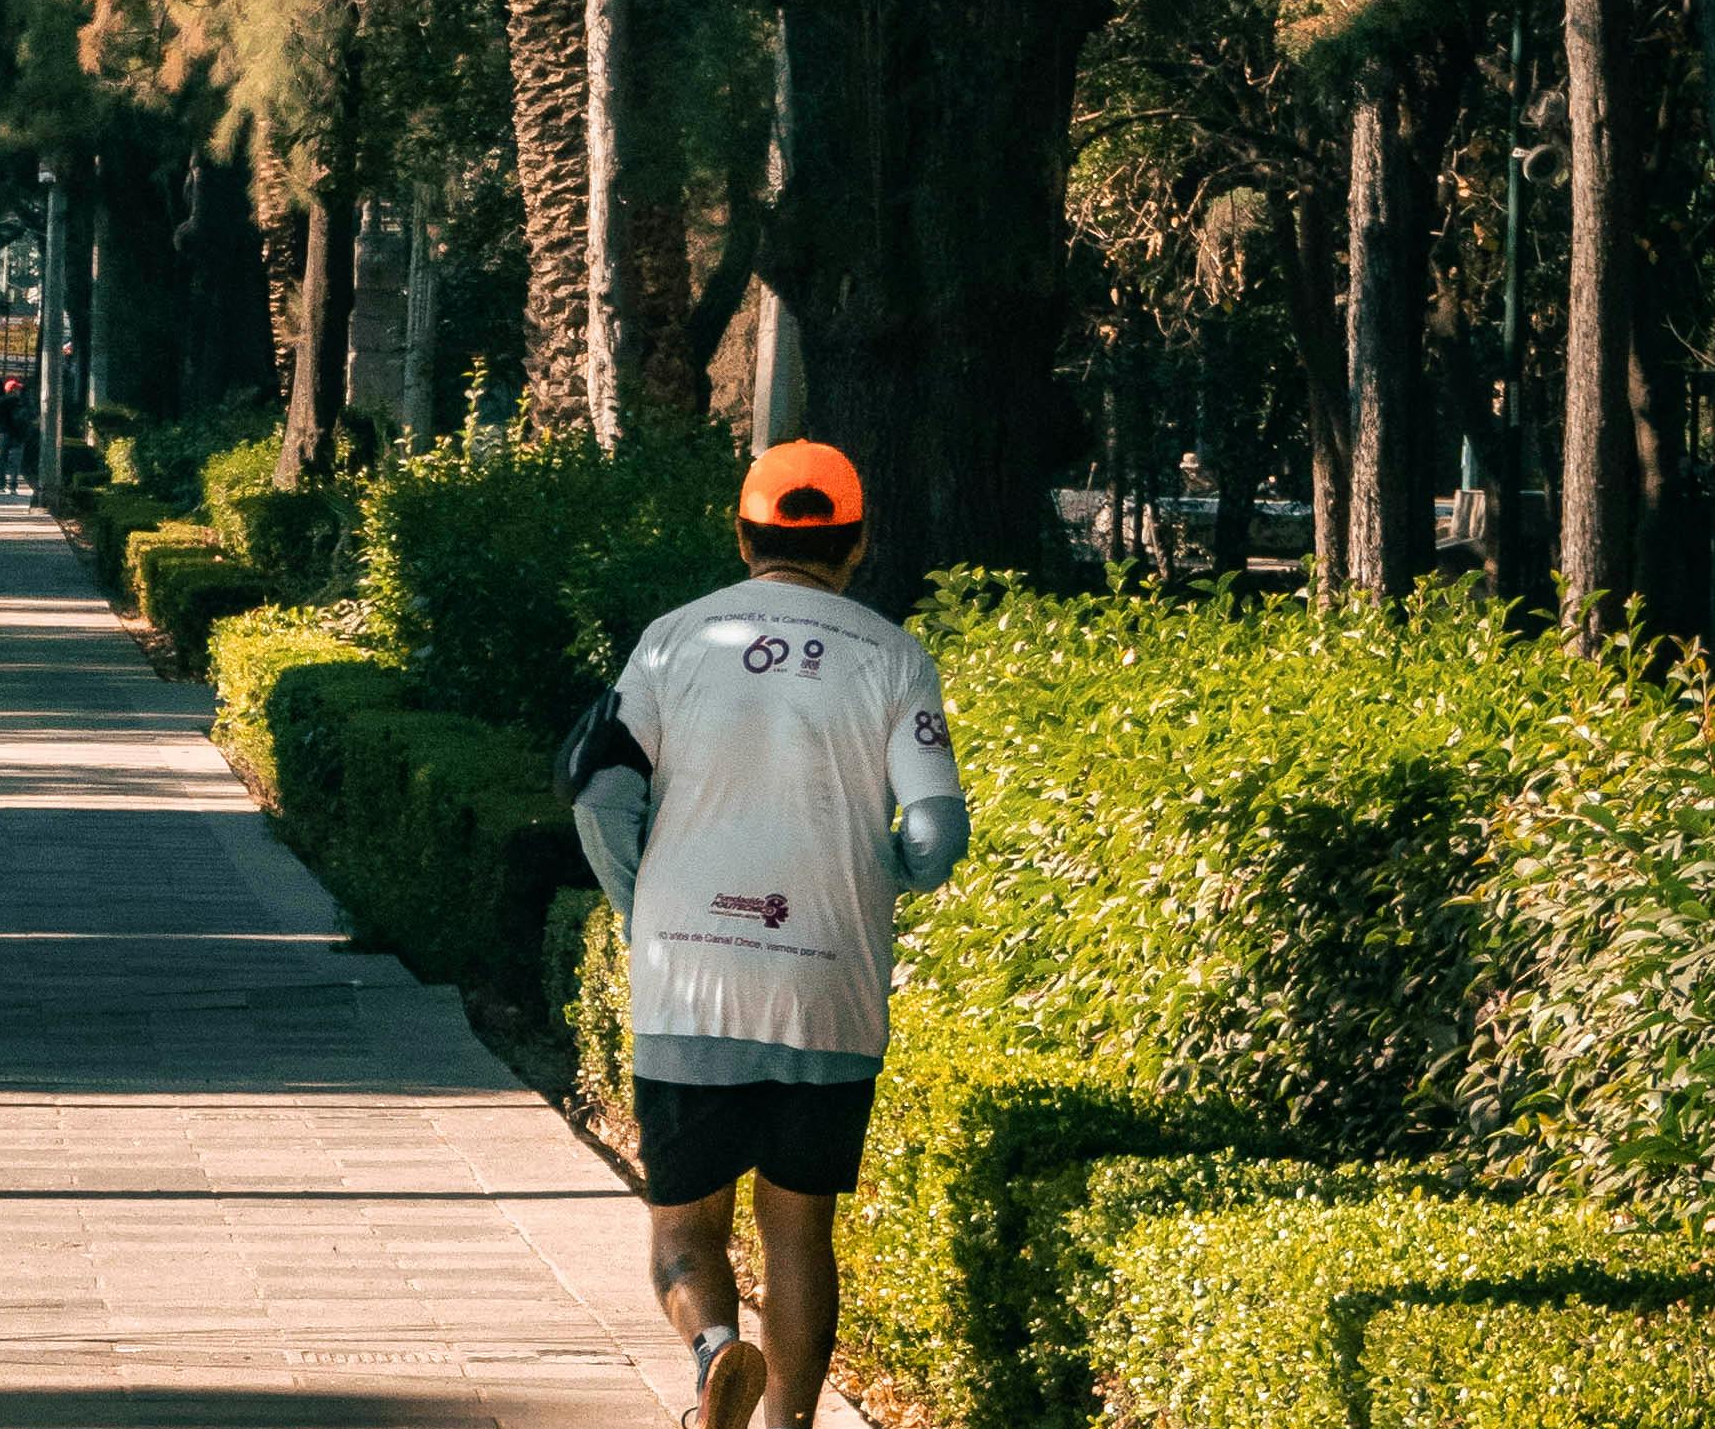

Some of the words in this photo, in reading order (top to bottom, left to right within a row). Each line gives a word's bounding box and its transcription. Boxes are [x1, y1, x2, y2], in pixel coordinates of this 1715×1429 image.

[743, 635, 790, 674] 60
[691, 932, 703, 942] de
[704, 932, 734, 946] Canal
